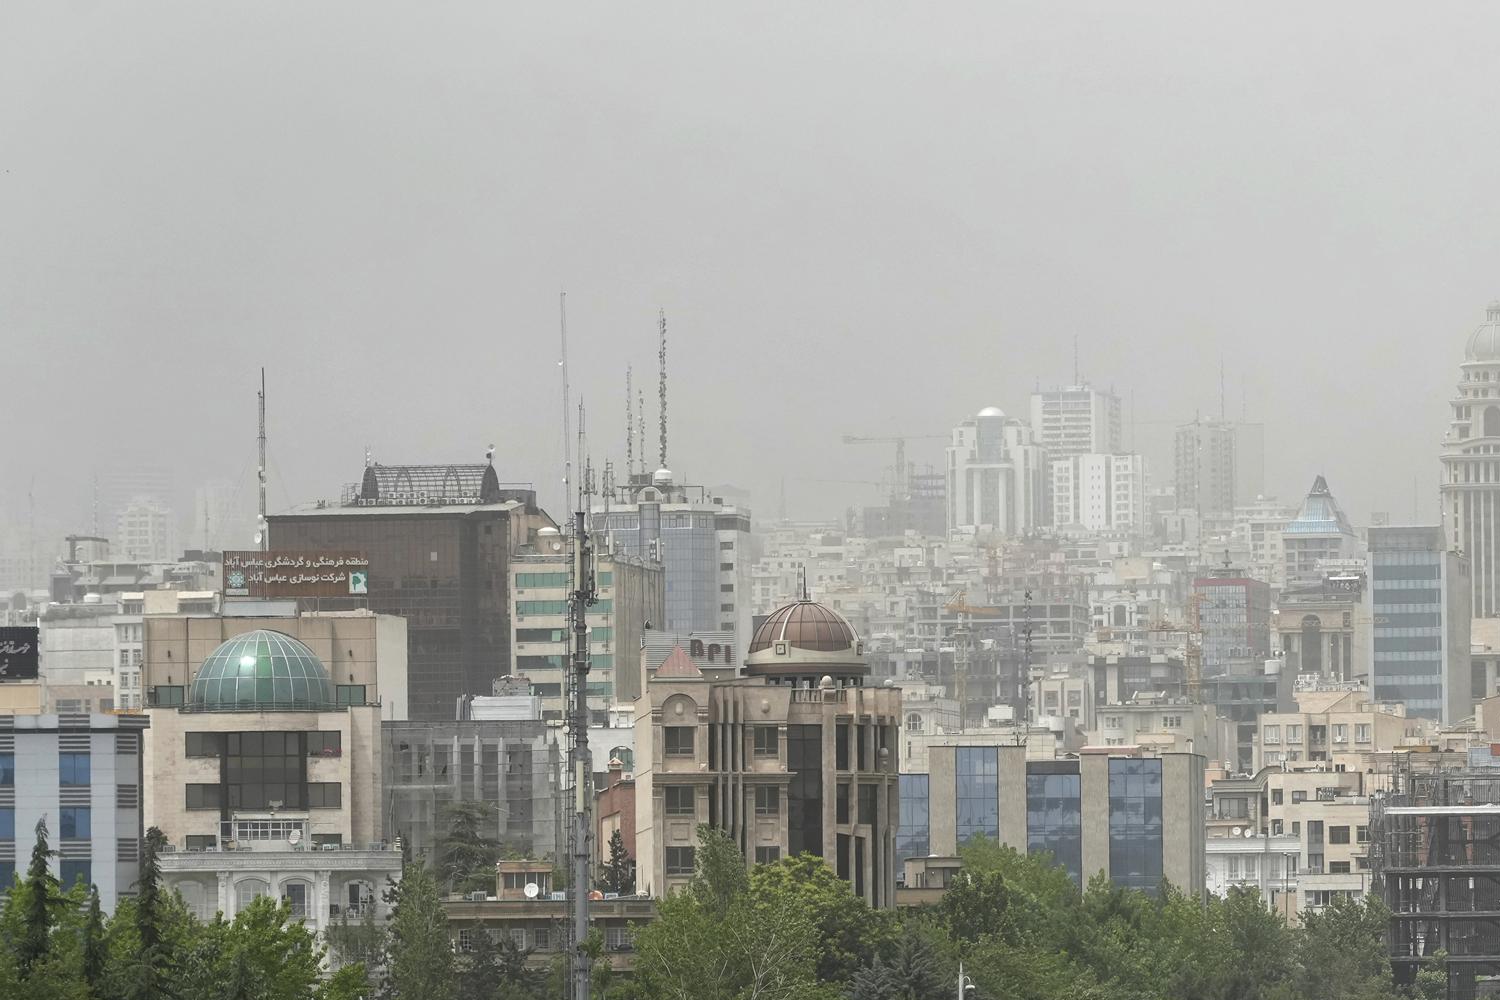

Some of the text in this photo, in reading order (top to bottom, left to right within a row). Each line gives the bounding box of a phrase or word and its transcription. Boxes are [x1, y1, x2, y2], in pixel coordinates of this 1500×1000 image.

[224, 556, 369, 569] منطقه فرهنگی و گردشگری عباس آباد
[247, 571, 346, 584] شرکت نوسازی عباس آباد
